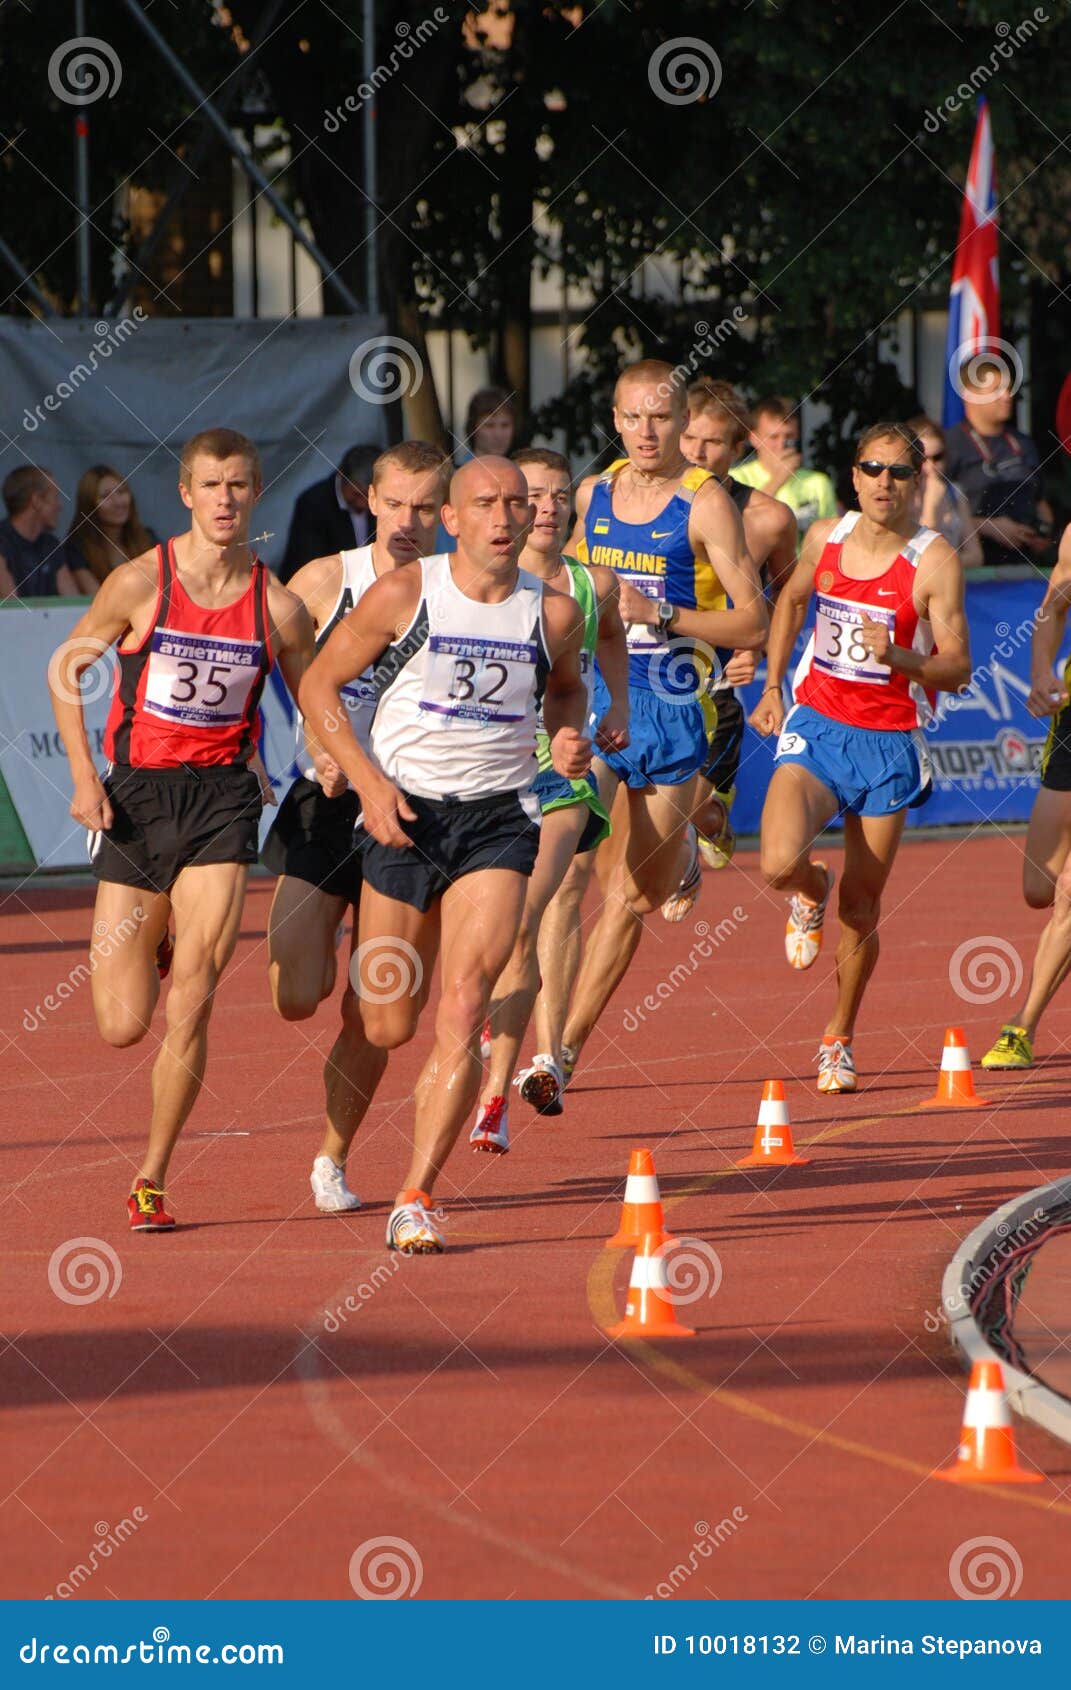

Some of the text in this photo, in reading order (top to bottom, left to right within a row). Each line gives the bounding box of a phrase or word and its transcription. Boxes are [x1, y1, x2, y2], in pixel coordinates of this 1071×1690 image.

[591, 545, 667, 575] UKRAINE
[159, 641, 253, 665] атлетика
[437, 641, 531, 662] атлетика
[826, 621, 870, 663] 38
[170, 661, 232, 707] 35
[448, 659, 508, 705] 32
[781, 735, 798, 752] 3
